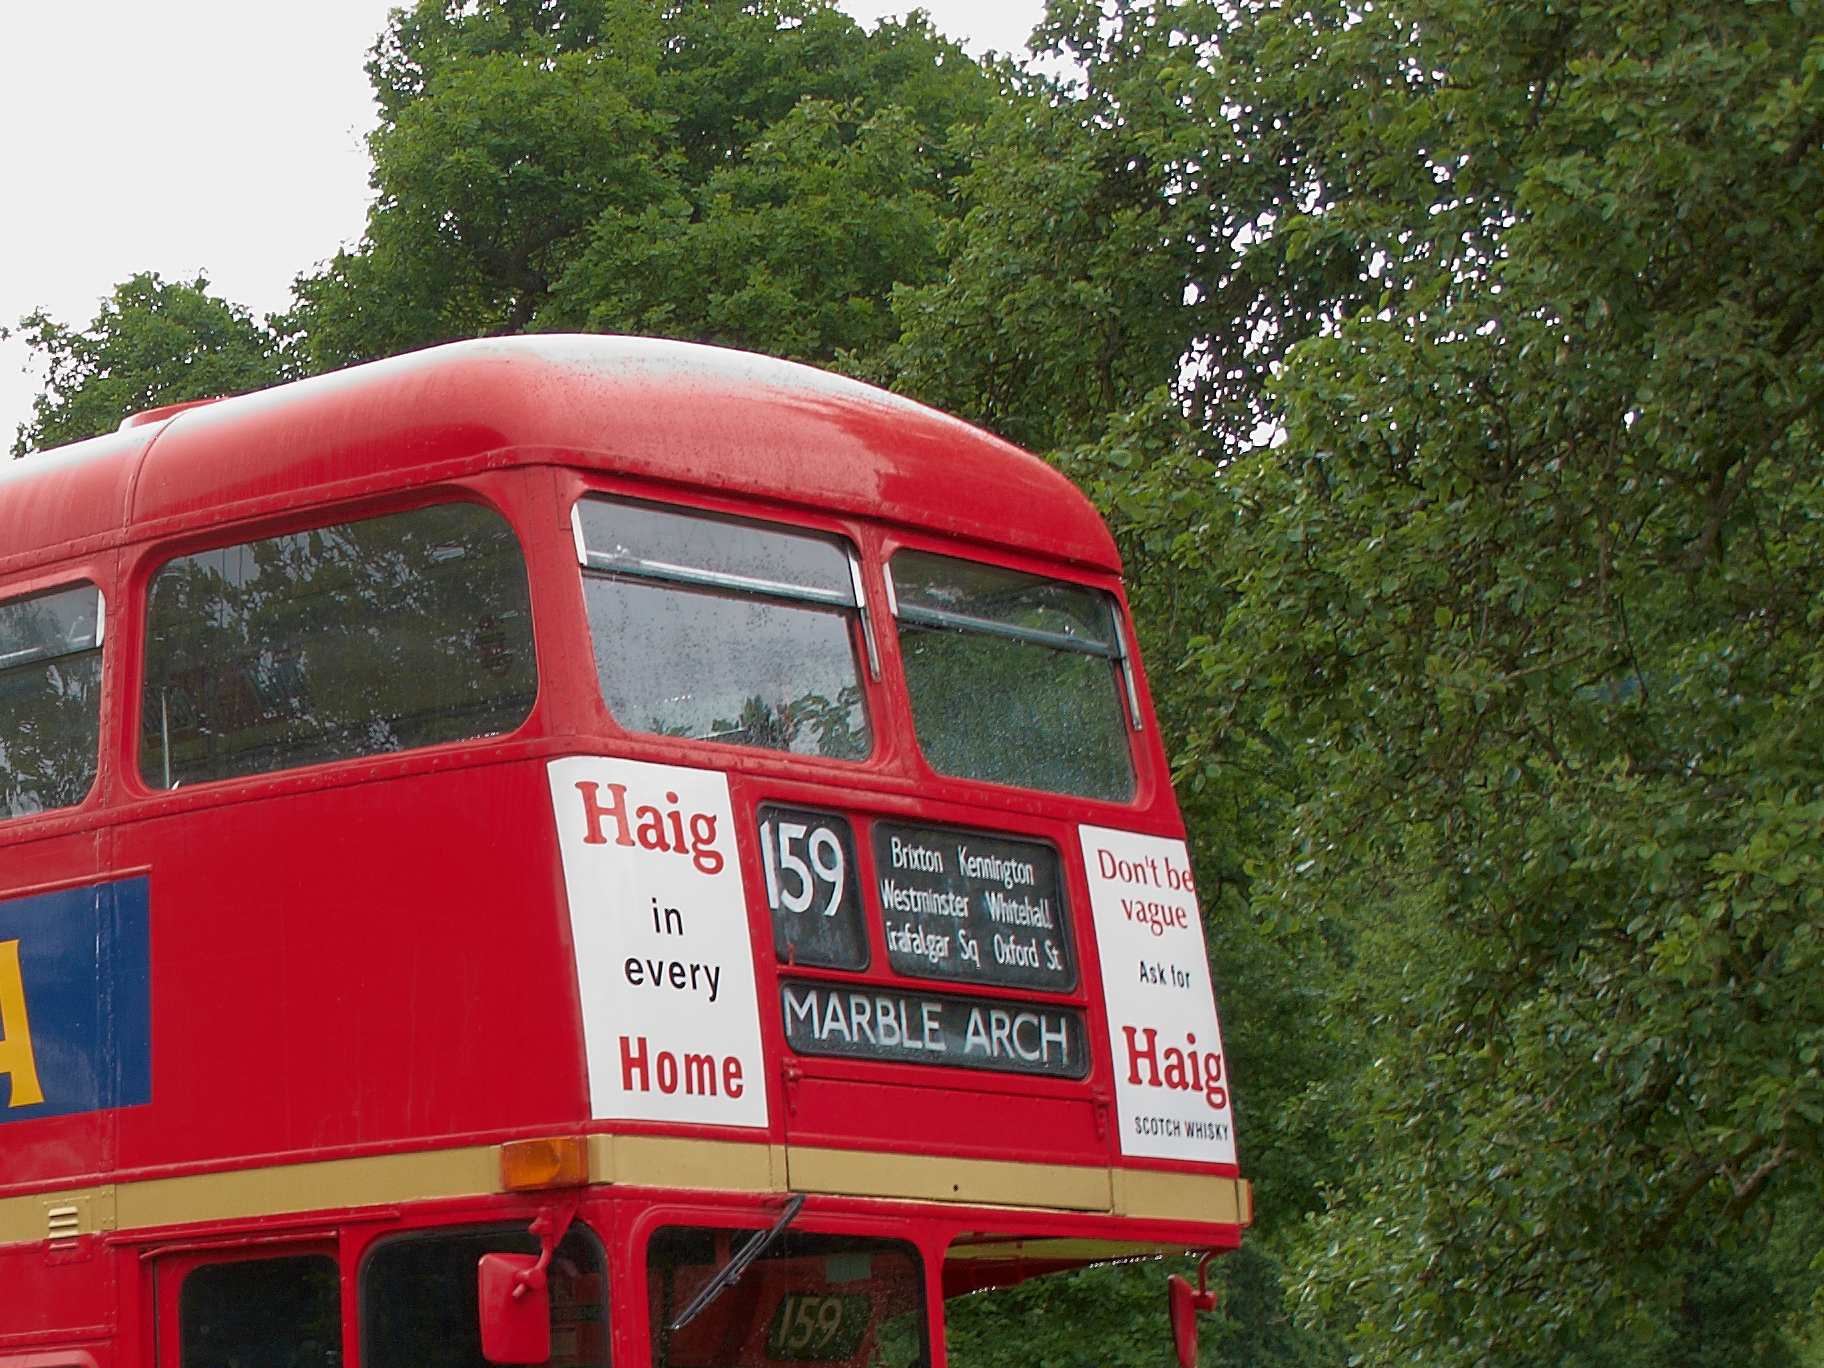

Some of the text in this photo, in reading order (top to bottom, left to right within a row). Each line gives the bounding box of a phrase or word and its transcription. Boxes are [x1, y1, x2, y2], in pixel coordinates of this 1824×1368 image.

[575, 781, 724, 875] Haig
[760, 821, 844, 916] 159
[890, 836, 1035, 890] Brixton Kennington
[1098, 849, 1194, 892] Don't be
[651, 898, 684, 935] in
[880, 879, 1053, 930] Westminster Whitehall
[1121, 899, 1188, 936] vague
[886, 921, 1063, 971] Trafalgar Sq Oxford St
[625, 957, 721, 1002] every
[1138, 960, 1191, 989] Ask for
[783, 988, 1069, 1066] MARBLE ARCH
[619, 1035, 745, 1100] Home
[1122, 1025, 1227, 1110] Haig
[1134, 1116, 1228, 1142] SCOTCH WHISKY
